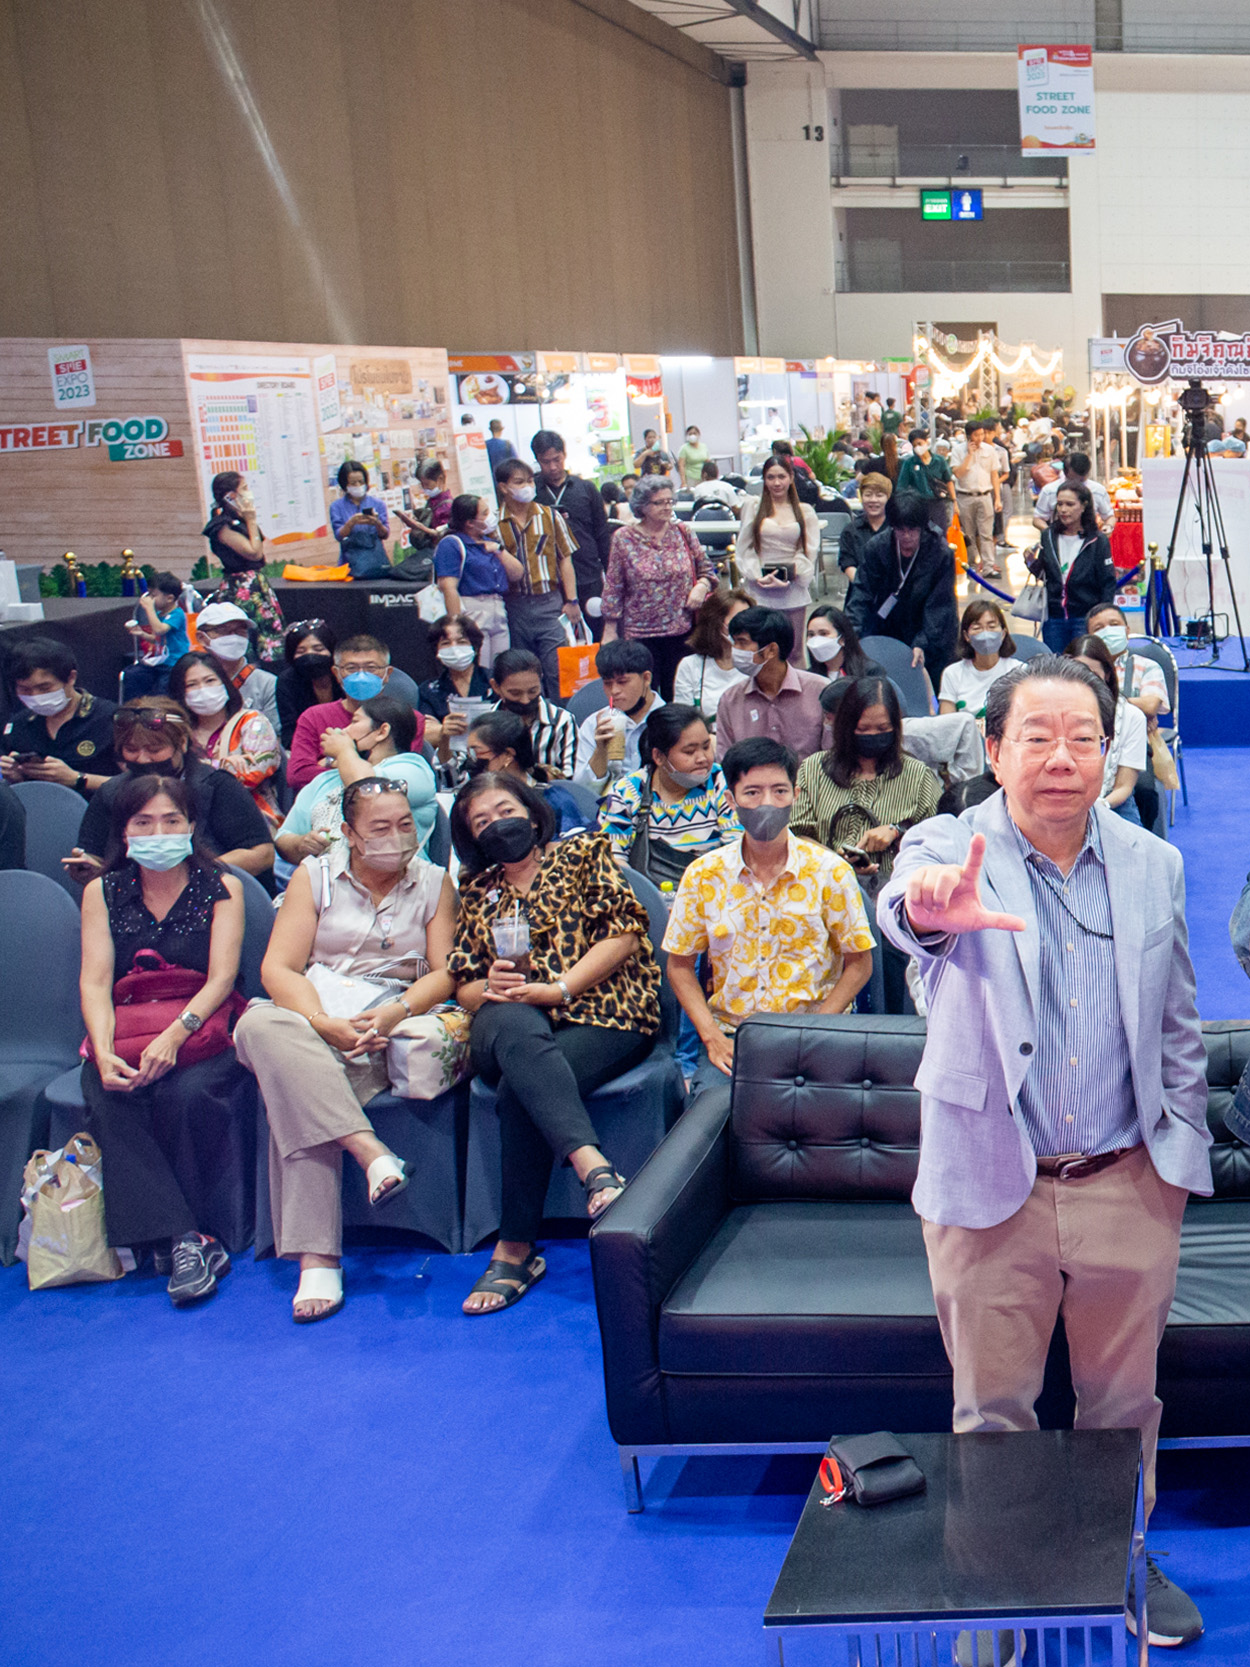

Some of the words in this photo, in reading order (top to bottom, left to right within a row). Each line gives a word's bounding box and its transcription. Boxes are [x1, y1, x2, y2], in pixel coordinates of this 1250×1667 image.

[1036, 92, 1075, 101] STREET
[1026, 105, 1058, 114] FOOD
[1061, 105, 1091, 114] ZONE
[801, 124, 824, 142] 13
[924, 204, 948, 213] EXIT
[56, 373, 89, 388] EXPO
[58, 384, 91, 401] 2023
[0, 424, 79, 449] TREET
[88, 418, 163, 443] FOOD
[124, 442, 171, 459] ZONE
[369, 594, 416, 607] IMPAC
